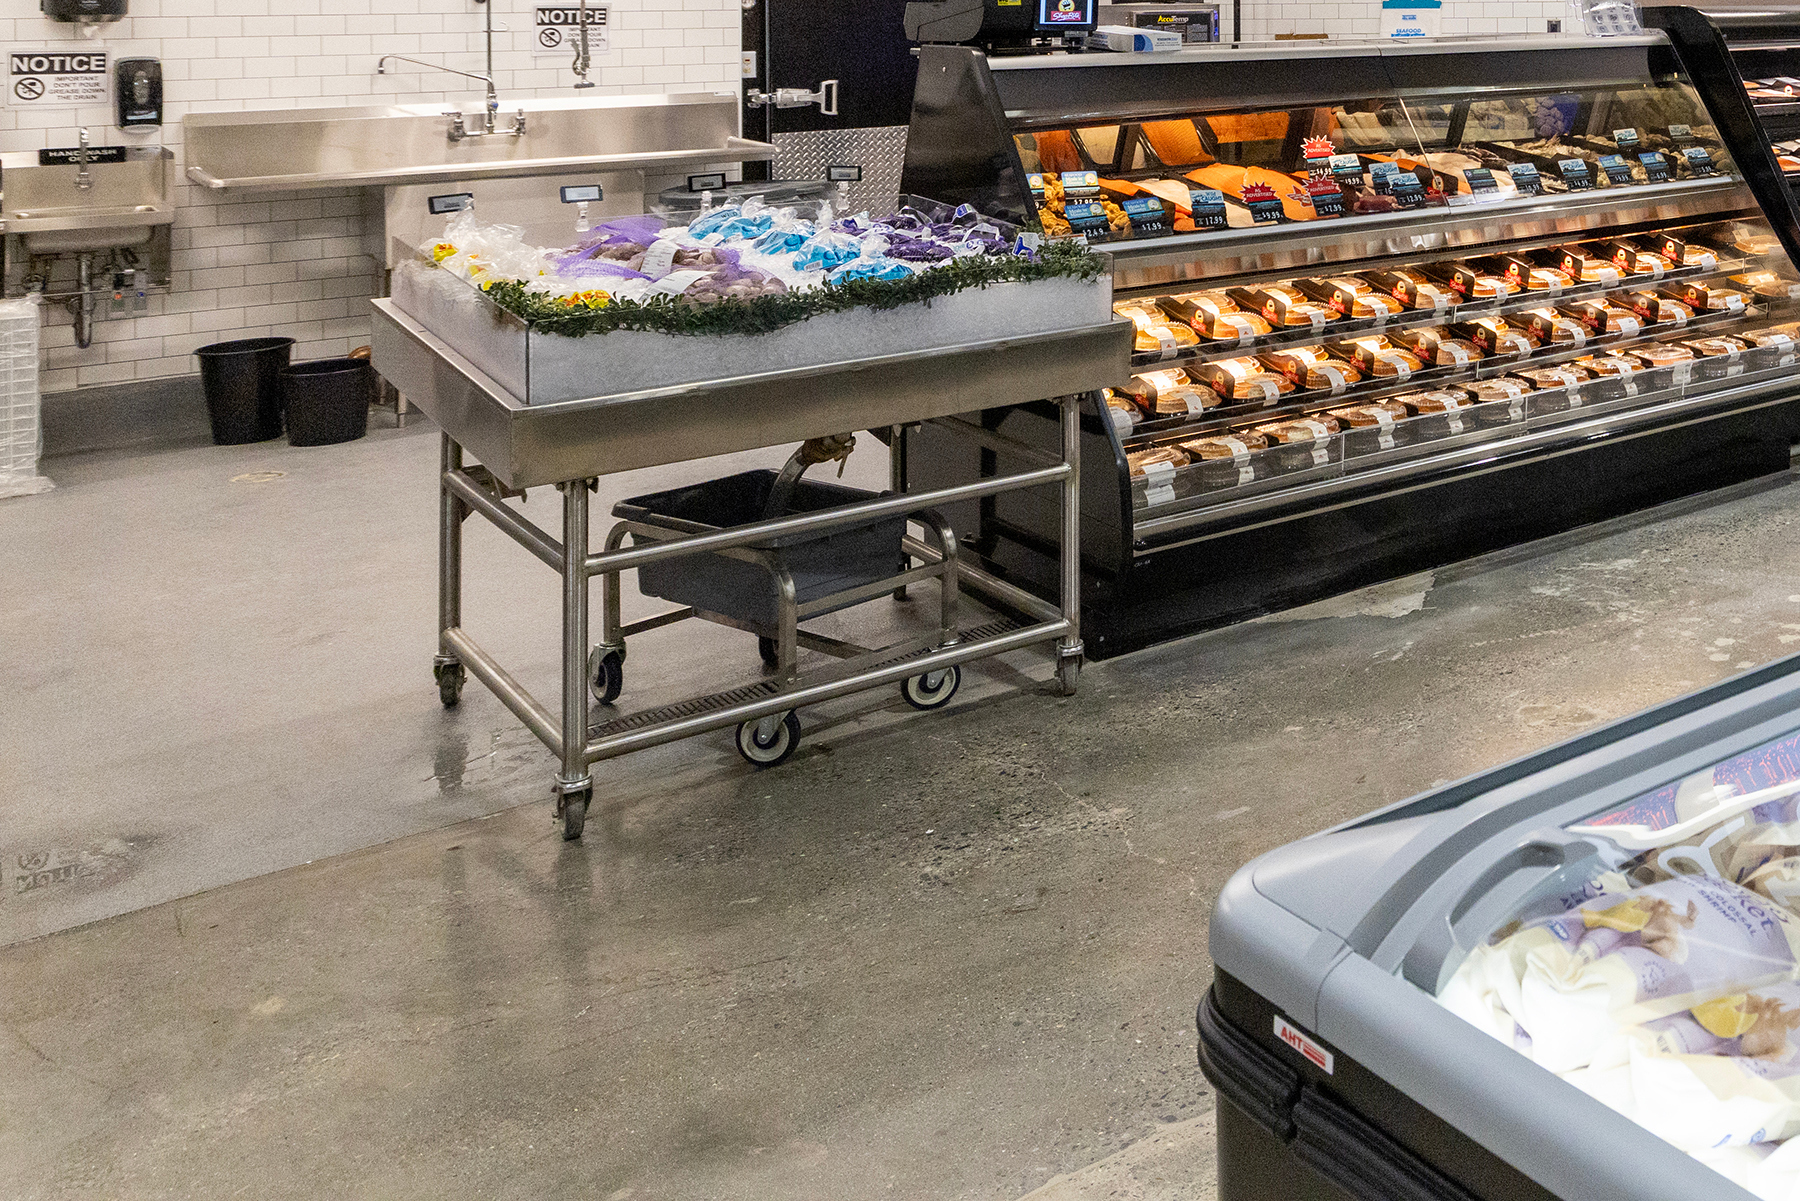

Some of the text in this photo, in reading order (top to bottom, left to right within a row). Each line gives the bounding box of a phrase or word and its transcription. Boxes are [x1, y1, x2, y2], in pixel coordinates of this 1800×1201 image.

[1158, 15, 1189, 23] AccuTemp
[11, 56, 106, 73] NOTICE
[1698, 889, 1737, 924] SHRIMP
[1709, 889, 1757, 937] COLOSSAL
[1281, 1027, 1302, 1049] AHT
